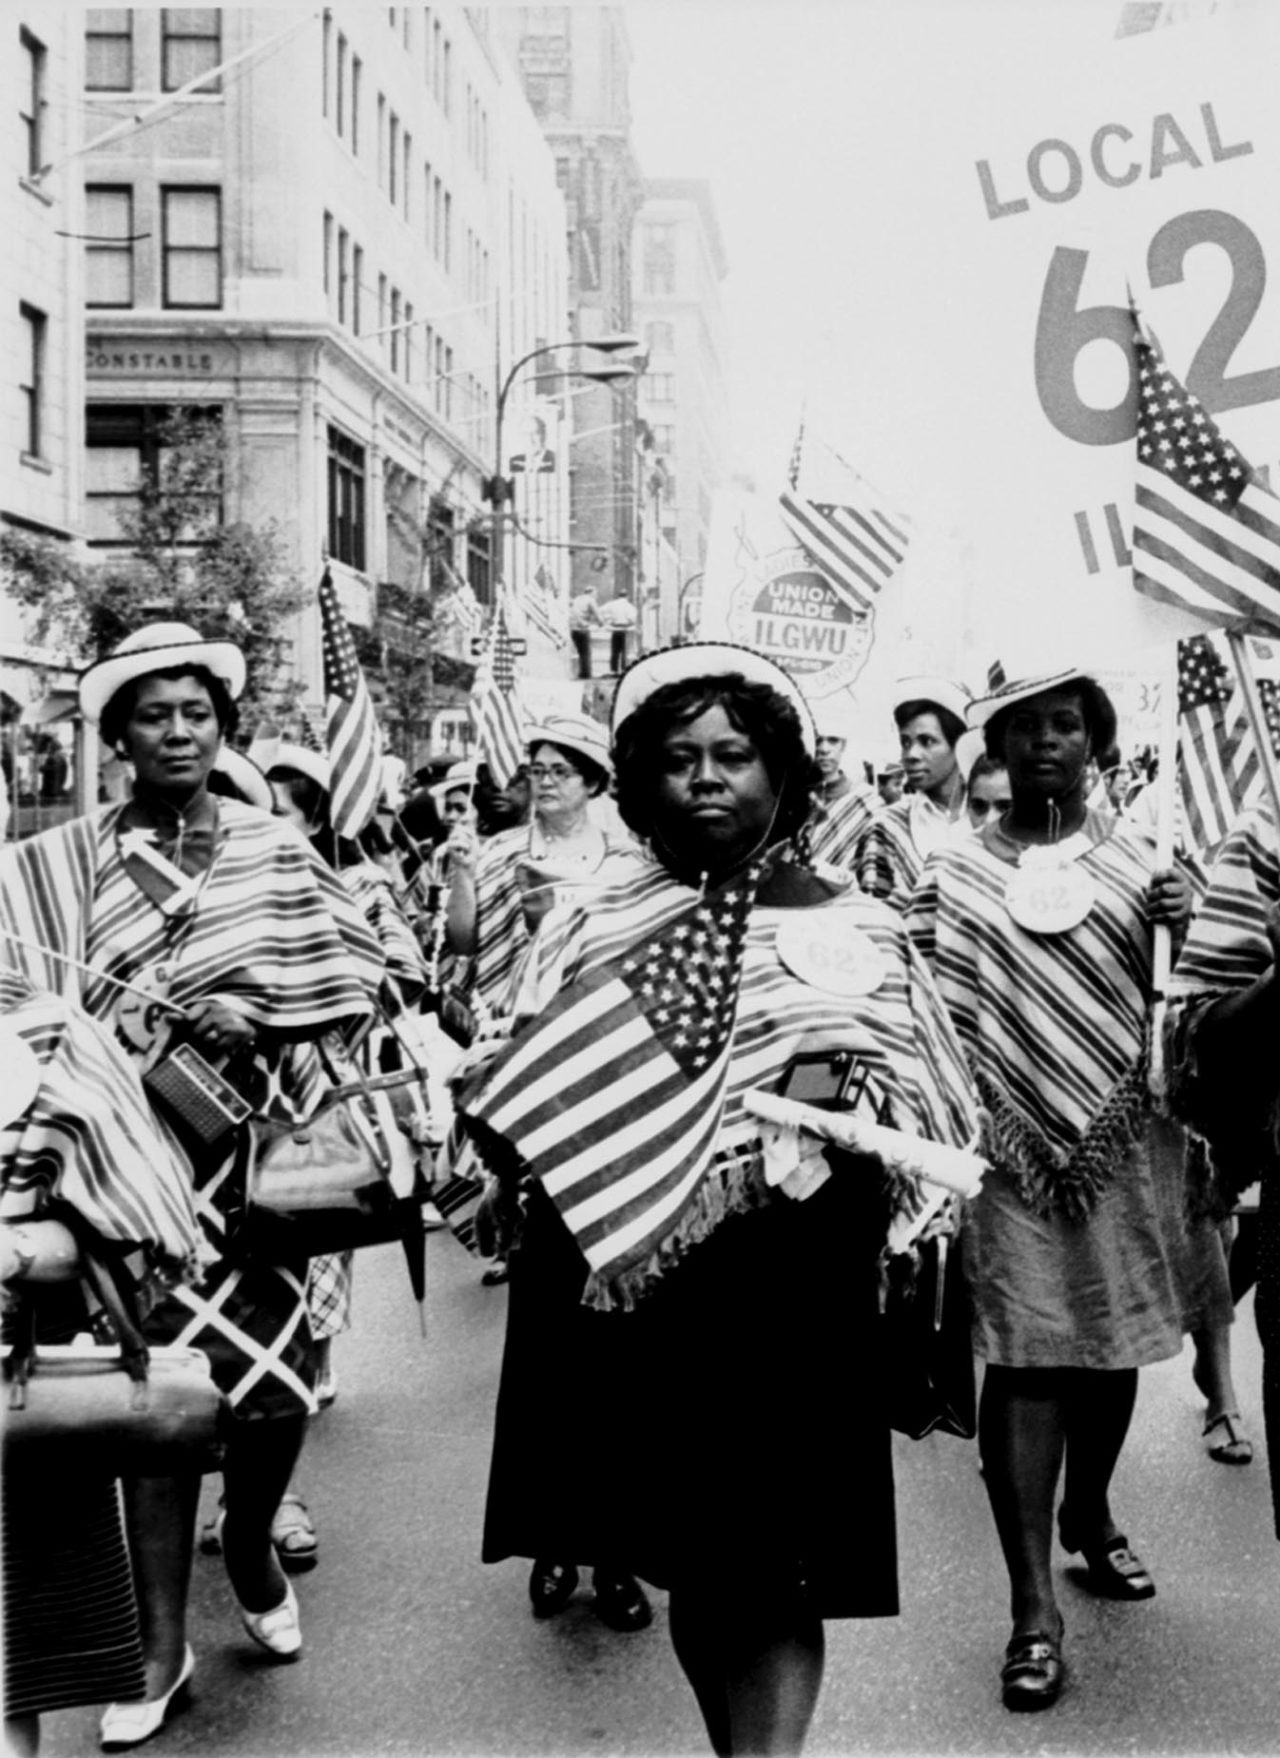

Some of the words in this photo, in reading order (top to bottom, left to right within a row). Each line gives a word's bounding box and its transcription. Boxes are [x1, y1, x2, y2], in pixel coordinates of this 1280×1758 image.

[975, 102, 1254, 220] LOCAL
[771, 599, 834, 619] MADE
[755, 619, 847, 655] ILGWU
[1028, 884, 1071, 914] 62
[807, 940, 857, 976] 62
